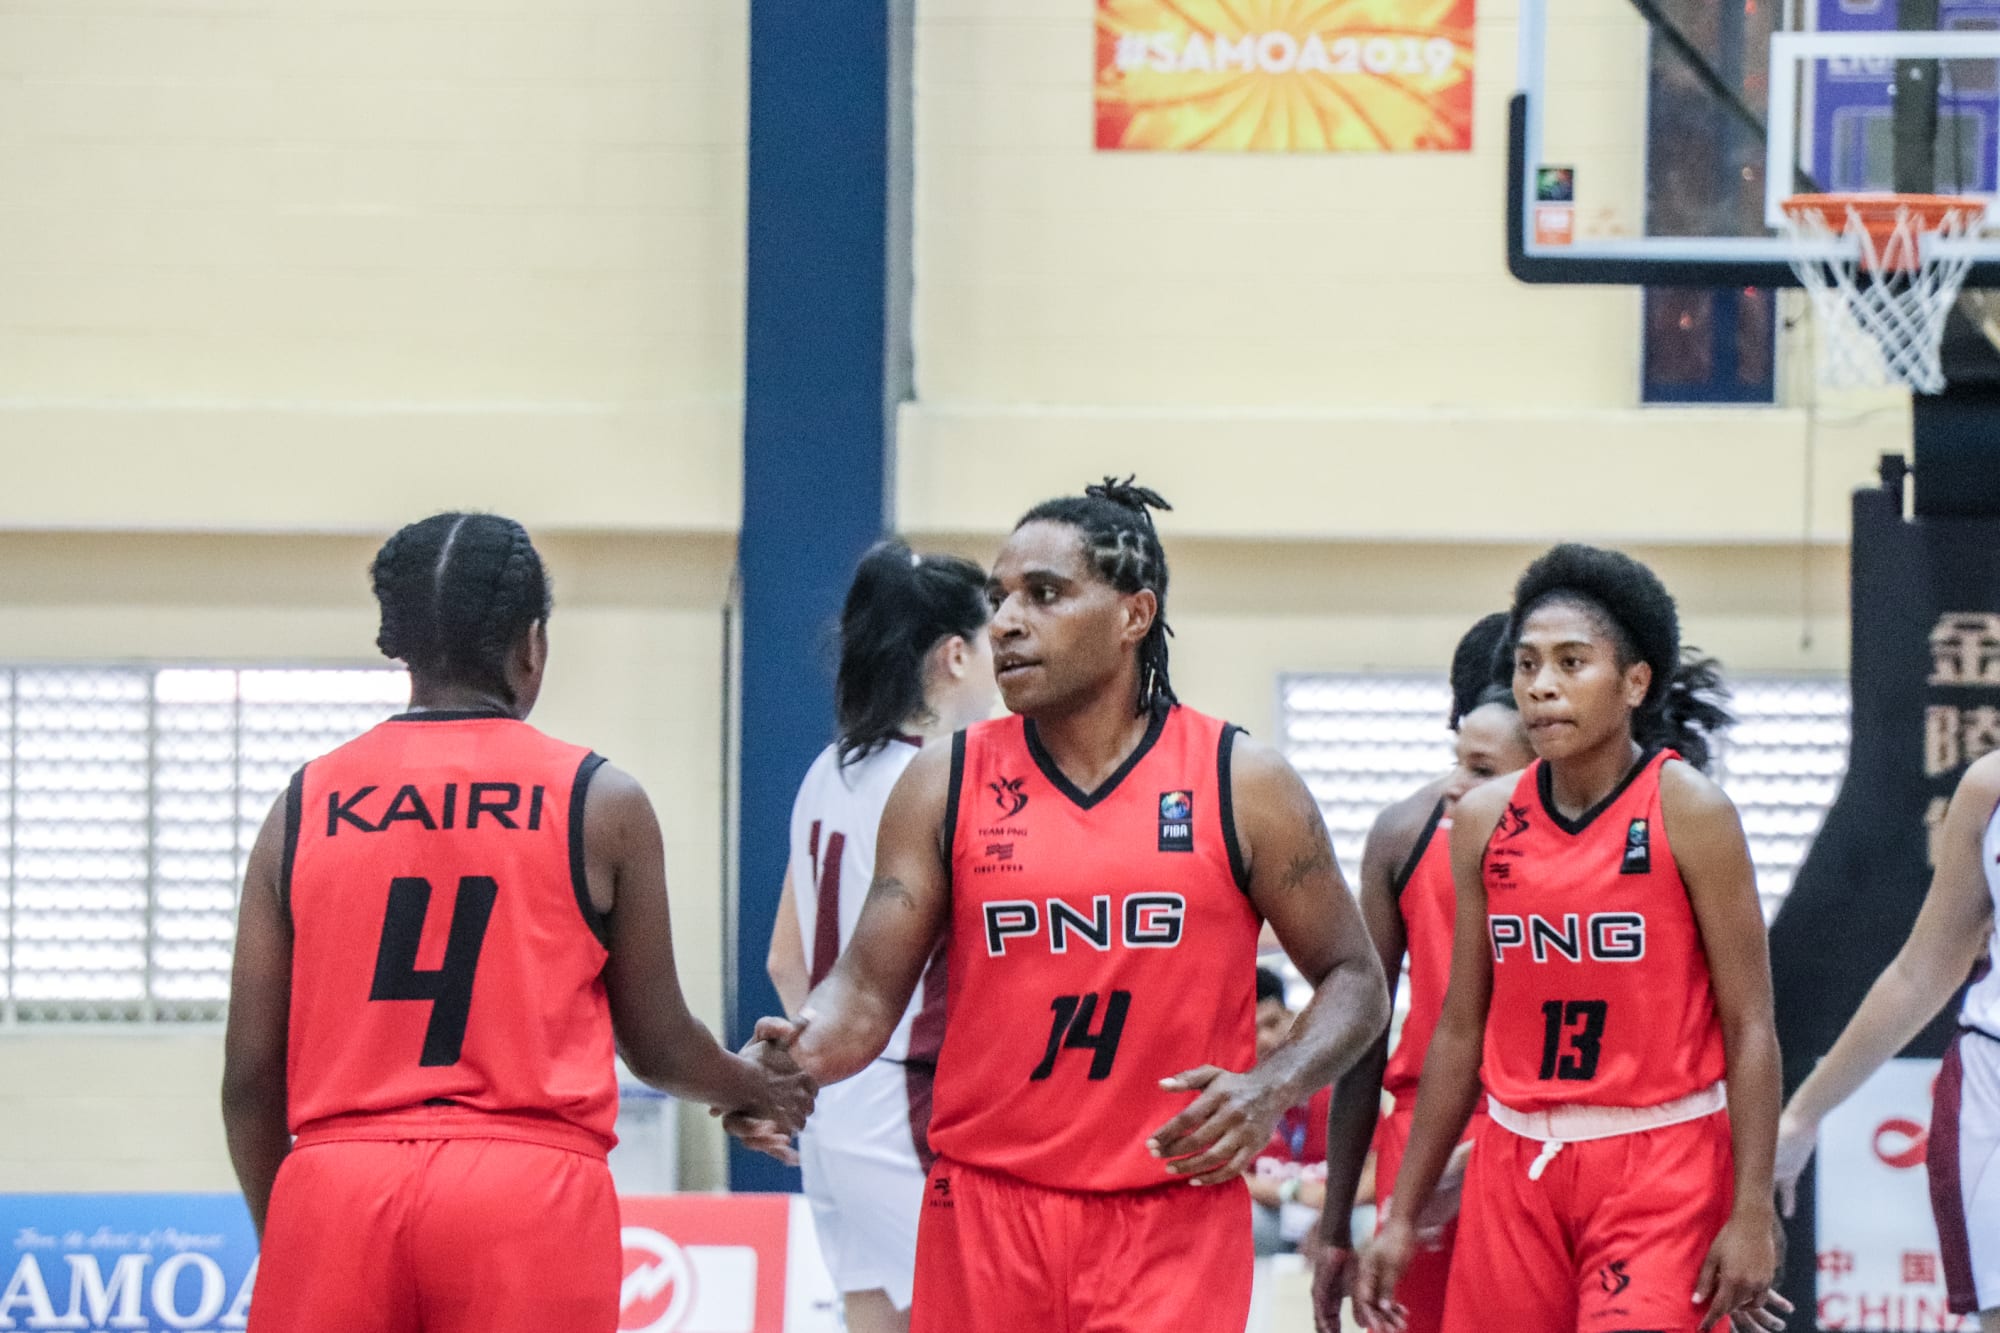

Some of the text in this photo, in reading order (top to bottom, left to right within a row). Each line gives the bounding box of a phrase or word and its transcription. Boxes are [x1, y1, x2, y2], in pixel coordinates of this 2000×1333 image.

[1115, 31, 1455, 78] #SAMOA2019
[326, 782, 545, 837] KAIRI
[1163, 824, 1188, 838] FIBA
[982, 891, 1186, 957] PNG
[1489, 912, 1645, 962] PNG
[368, 876, 499, 1067] 4
[1030, 990, 1132, 1081] 14
[1538, 999, 1607, 1080] 13
